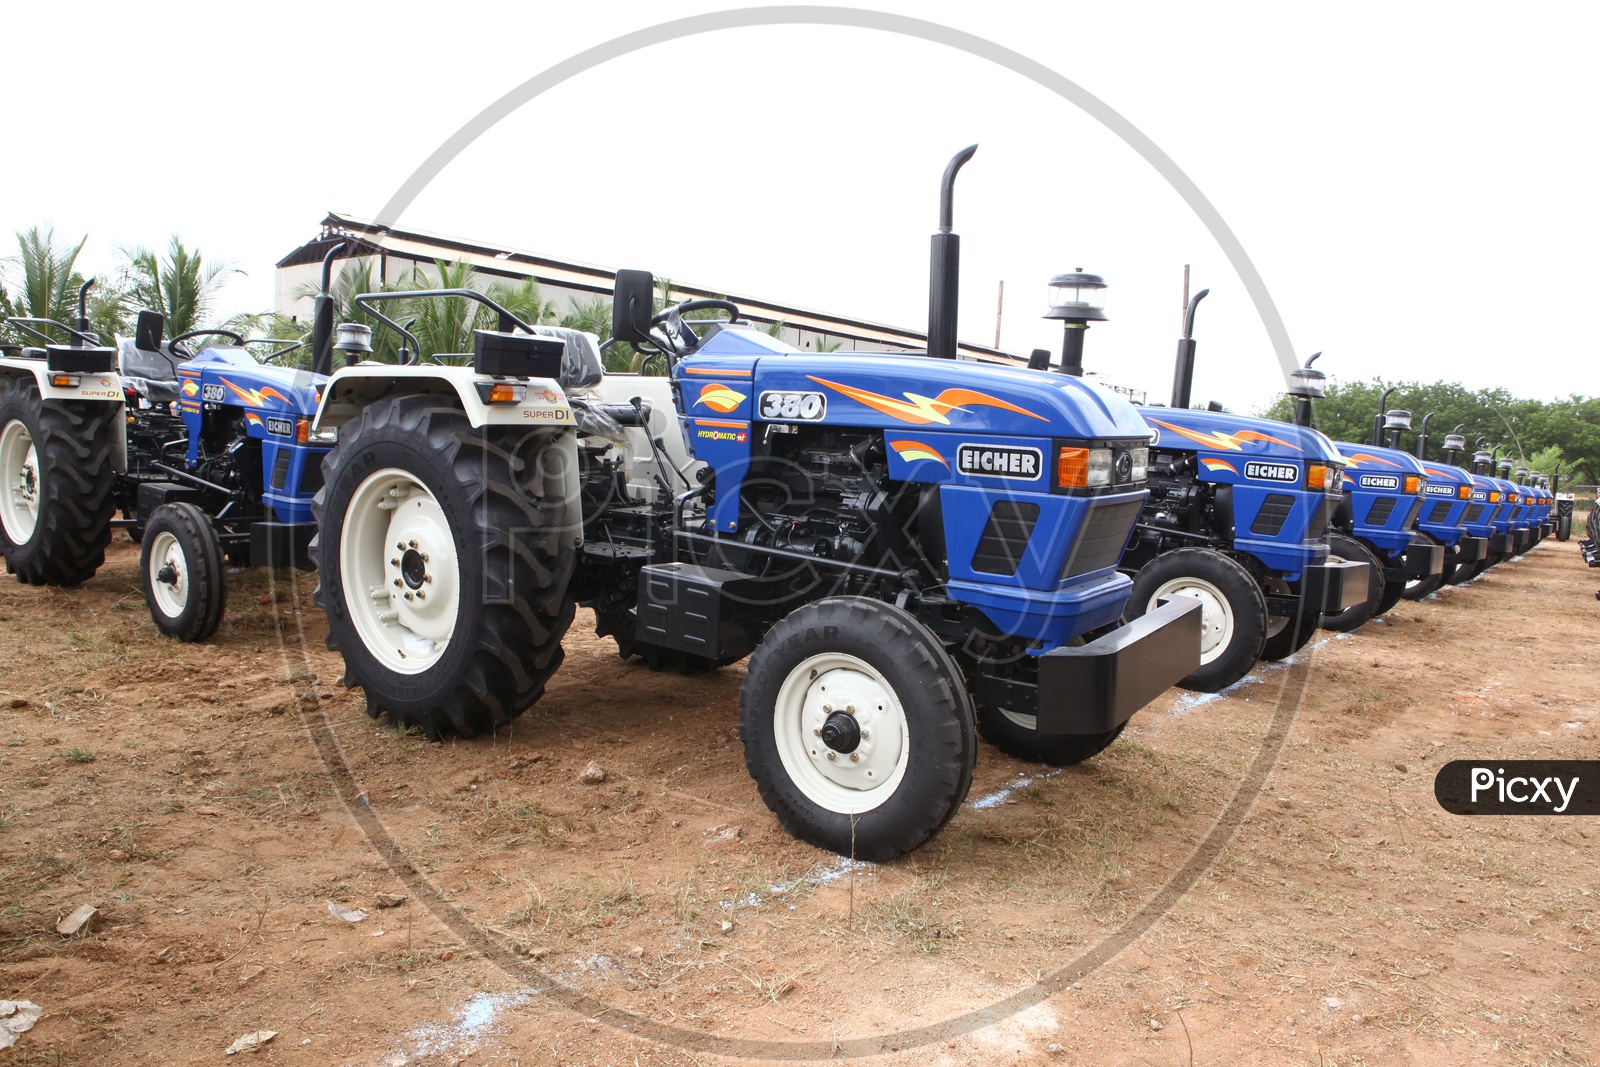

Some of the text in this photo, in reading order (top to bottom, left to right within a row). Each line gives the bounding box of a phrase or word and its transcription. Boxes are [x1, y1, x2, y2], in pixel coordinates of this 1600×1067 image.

[204, 386, 224, 401] 380
[763, 393, 822, 419] 380
[268, 420, 291, 435] EICHER
[697, 430, 737, 440] HYDROMATIC
[962, 450, 1036, 474] EICHER
[1247, 464, 1295, 480] EICHER
[1361, 477, 1396, 488] EICHER
[1426, 486, 1453, 495] EICHER
